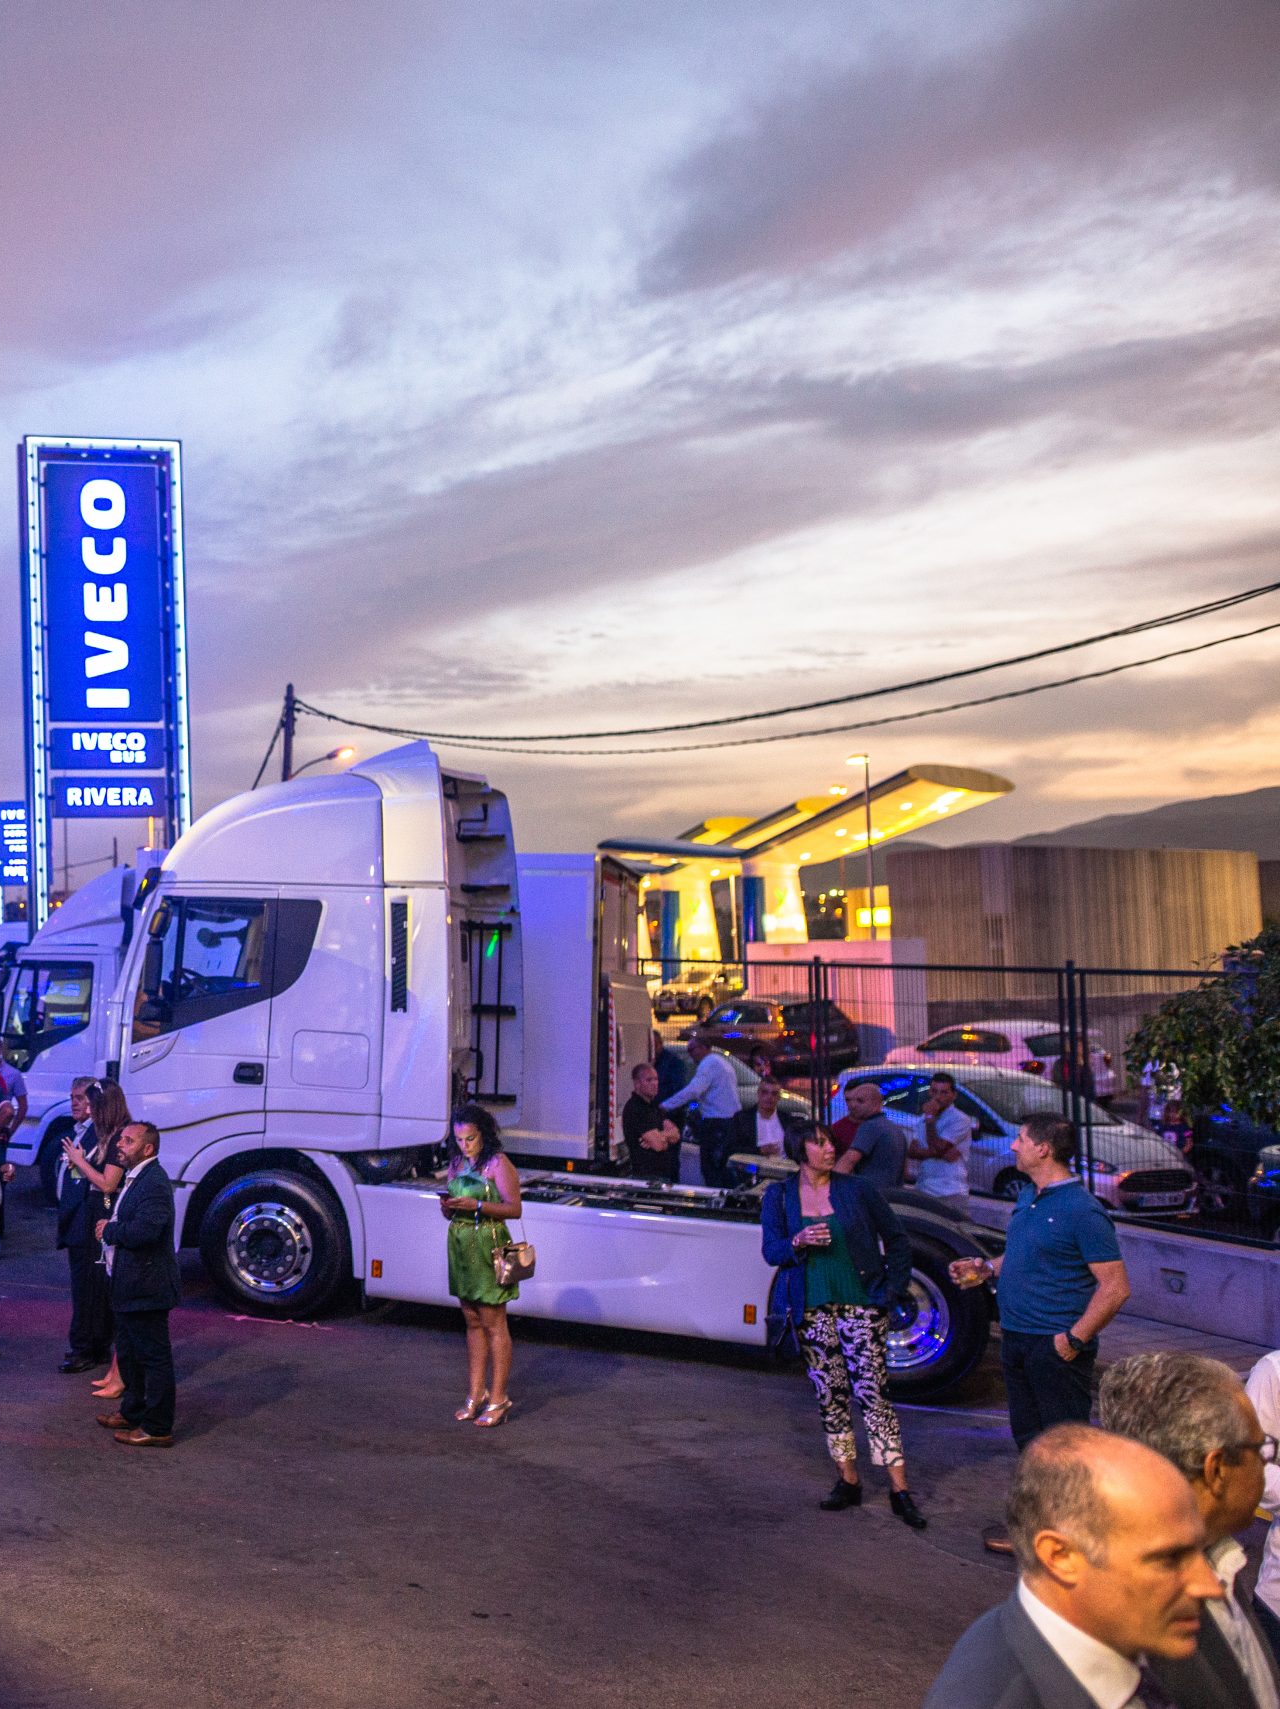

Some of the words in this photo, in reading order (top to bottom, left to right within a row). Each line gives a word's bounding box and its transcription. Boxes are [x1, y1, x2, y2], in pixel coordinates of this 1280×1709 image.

[80, 479, 130, 708] IVECO
[72, 732, 146, 750] IVECO
[110, 751, 146, 763] BUS
[67, 787, 153, 806] RIVERA
